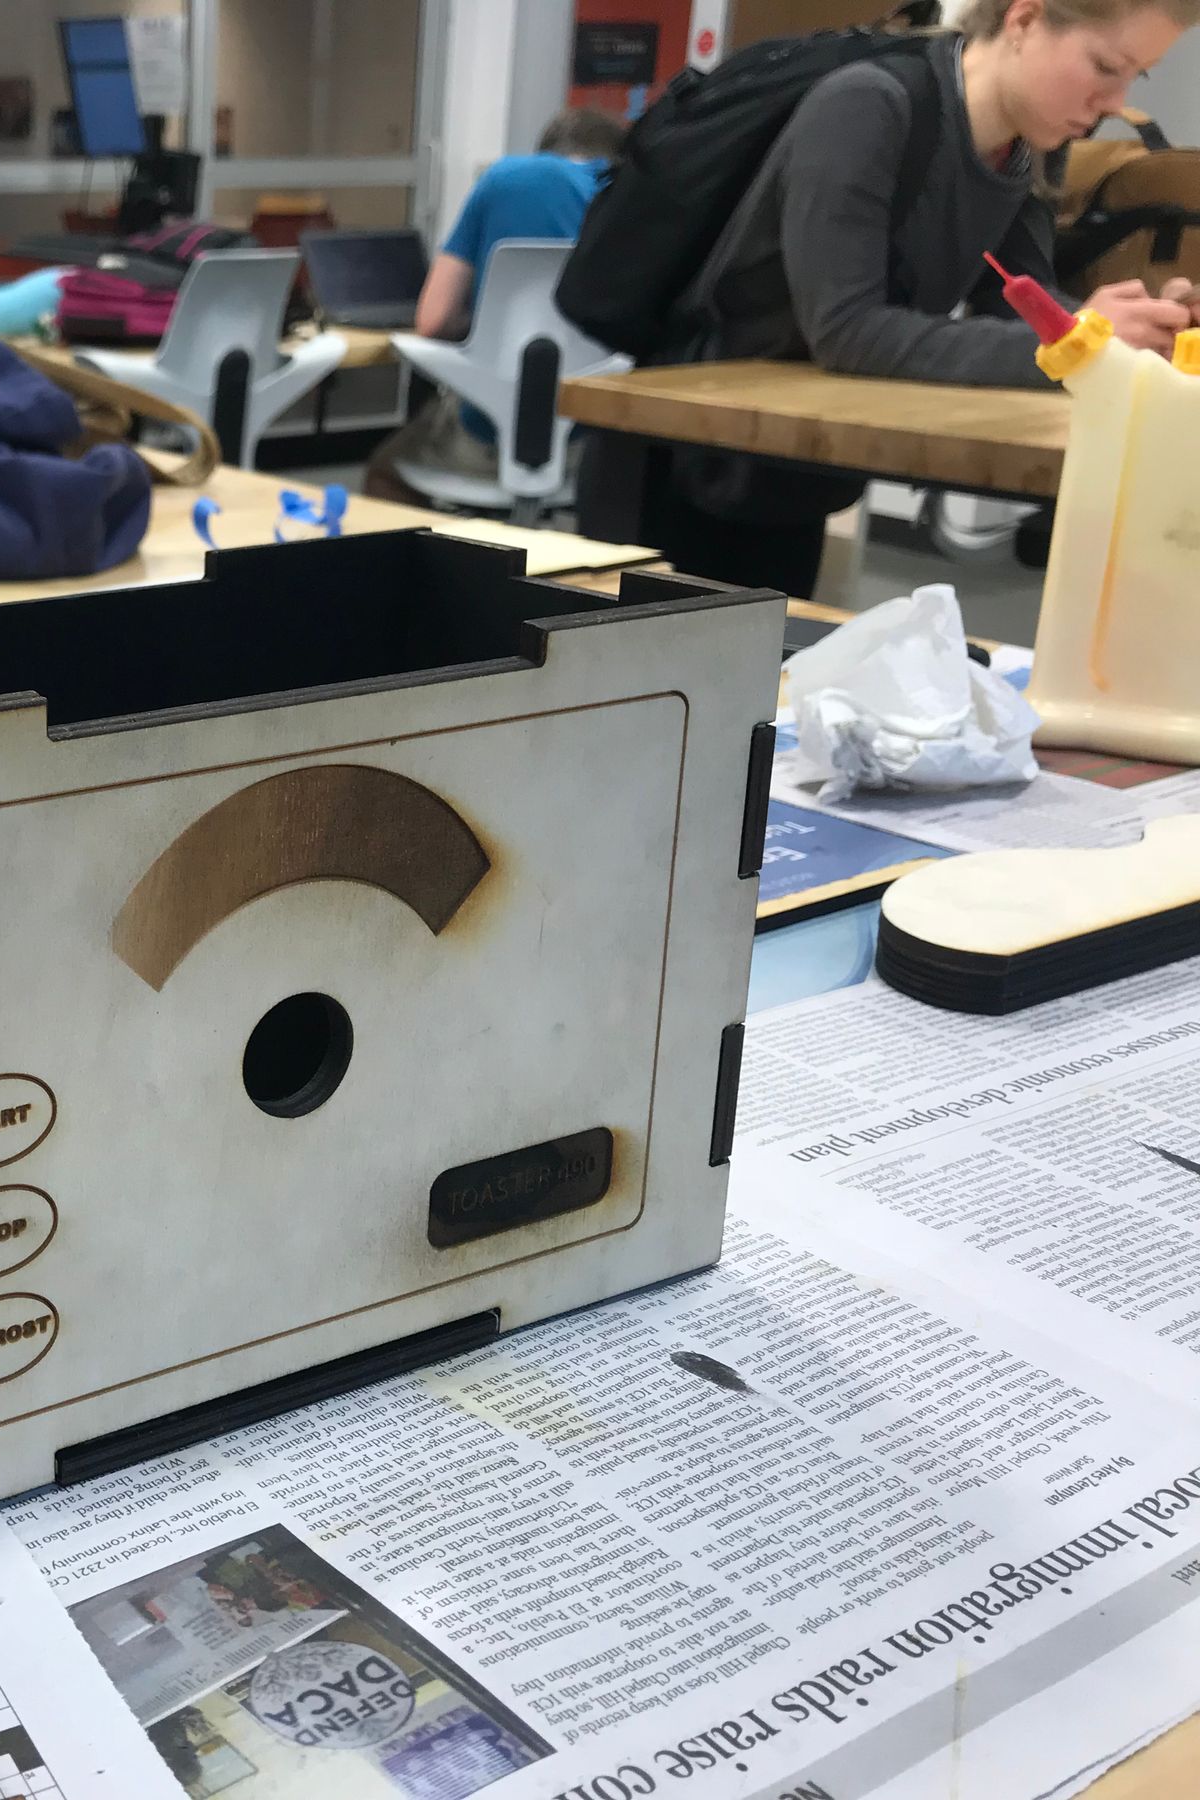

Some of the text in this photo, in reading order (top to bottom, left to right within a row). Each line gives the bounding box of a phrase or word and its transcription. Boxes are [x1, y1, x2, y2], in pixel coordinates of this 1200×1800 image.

[1003, 1053, 1115, 1095] economic
[849, 1087, 1014, 1144] development
[787, 1133, 856, 1164] plan
[448, 1165, 552, 1216] TOASTER
[944, 1423, 1083, 1498] week, Chapel Hill Mayor
[1042, 1454, 1095, 1485] Staff Writer
[1043, 1455, 1135, 1507] By Ares Zerunyan
[51, 1486, 244, 1571] ing with the Latinx community
[200, 1504, 243, 1530] Pueblo
[244, 1499, 257, 1513] El
[72, 1560, 103, 1580] 2321
[105, 1554, 118, 1567] in
[121, 1533, 171, 1561] located
[883, 1519, 1154, 1659] immigration
[512, 1592, 733, 1698] agents to provide information they
[263, 1655, 398, 1727] DACA
[294, 1679, 417, 1746] DEFEND
[564, 1631, 789, 1745] Chapel Hill does not keep records of
[771, 1648, 898, 1725] raids
[654, 1709, 782, 1779] raise
